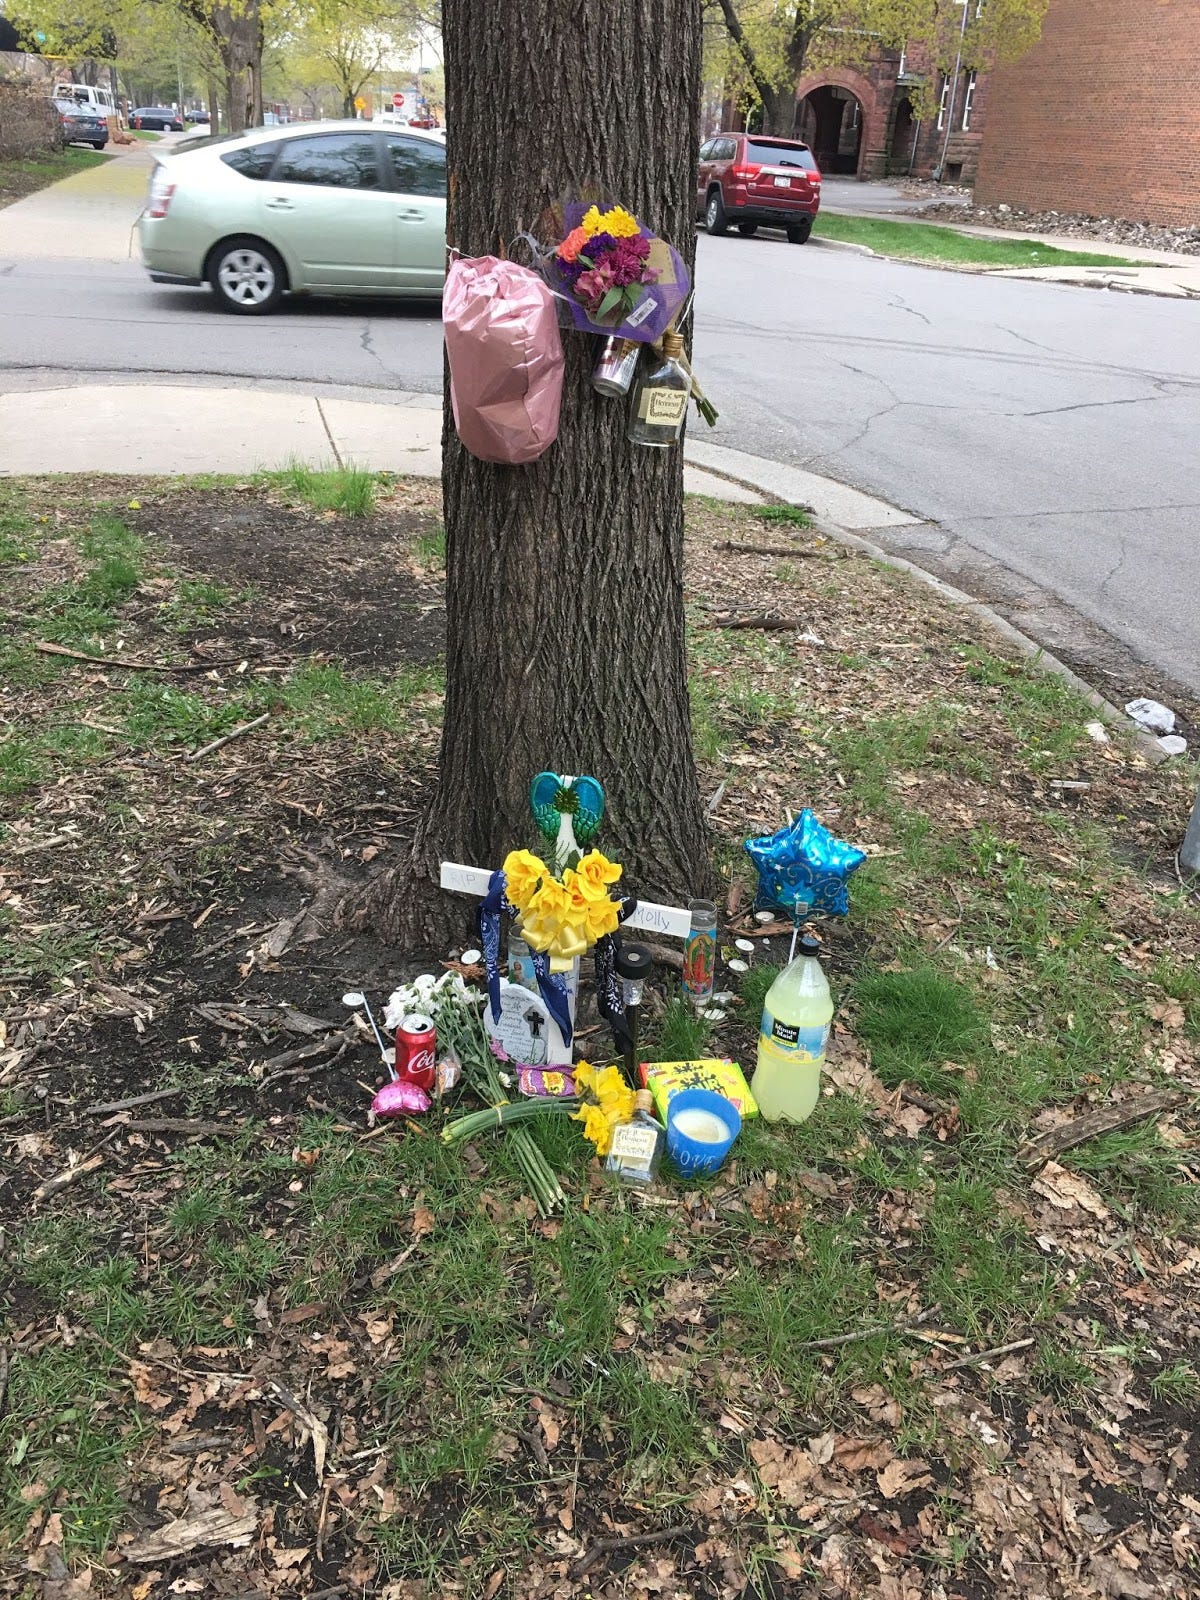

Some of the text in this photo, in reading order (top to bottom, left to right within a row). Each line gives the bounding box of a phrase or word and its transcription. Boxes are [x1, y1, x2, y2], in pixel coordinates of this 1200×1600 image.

[633, 906, 670, 931] Molly
[775, 1022, 797, 1036] Minute
[776, 1030, 793, 1040] Maid
